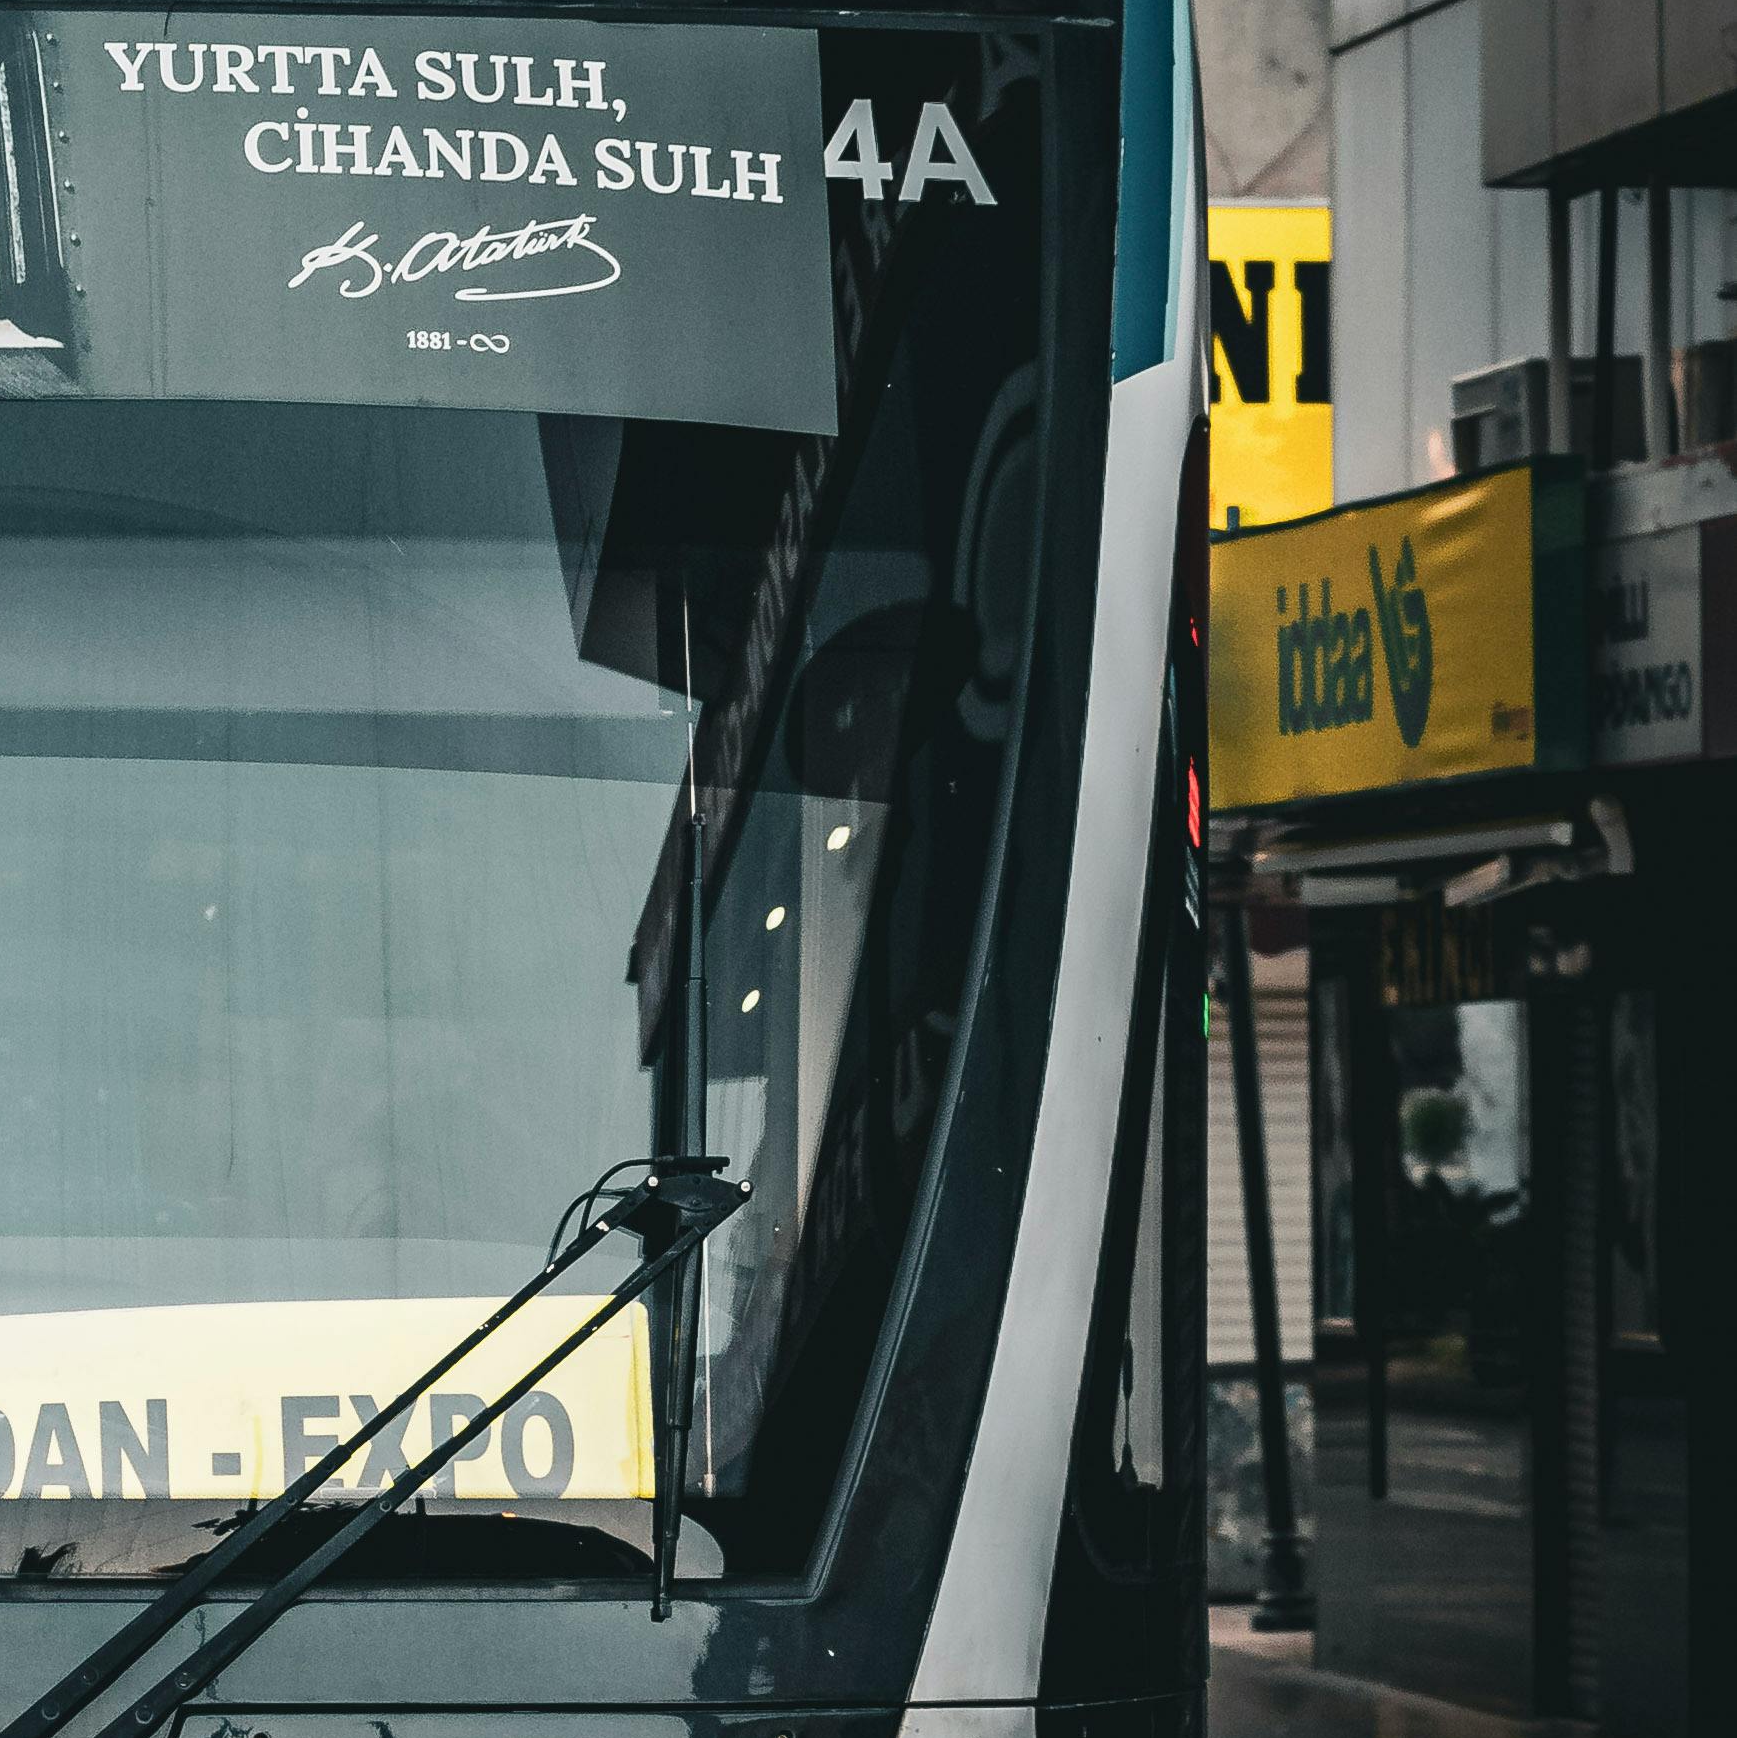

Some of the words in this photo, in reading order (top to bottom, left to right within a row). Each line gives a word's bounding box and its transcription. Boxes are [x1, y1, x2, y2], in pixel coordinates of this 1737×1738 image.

[103, 42, 398, 98] YURTTA
[415, 50, 627, 122] SULH,
[244, 106, 578, 186] CİHANDA
[594, 138, 784, 204] SULH
[824, 98, 998, 206] 4A
[406, 330, 452, 350] 1881
[280, 1392, 575, 1499] EXPO
